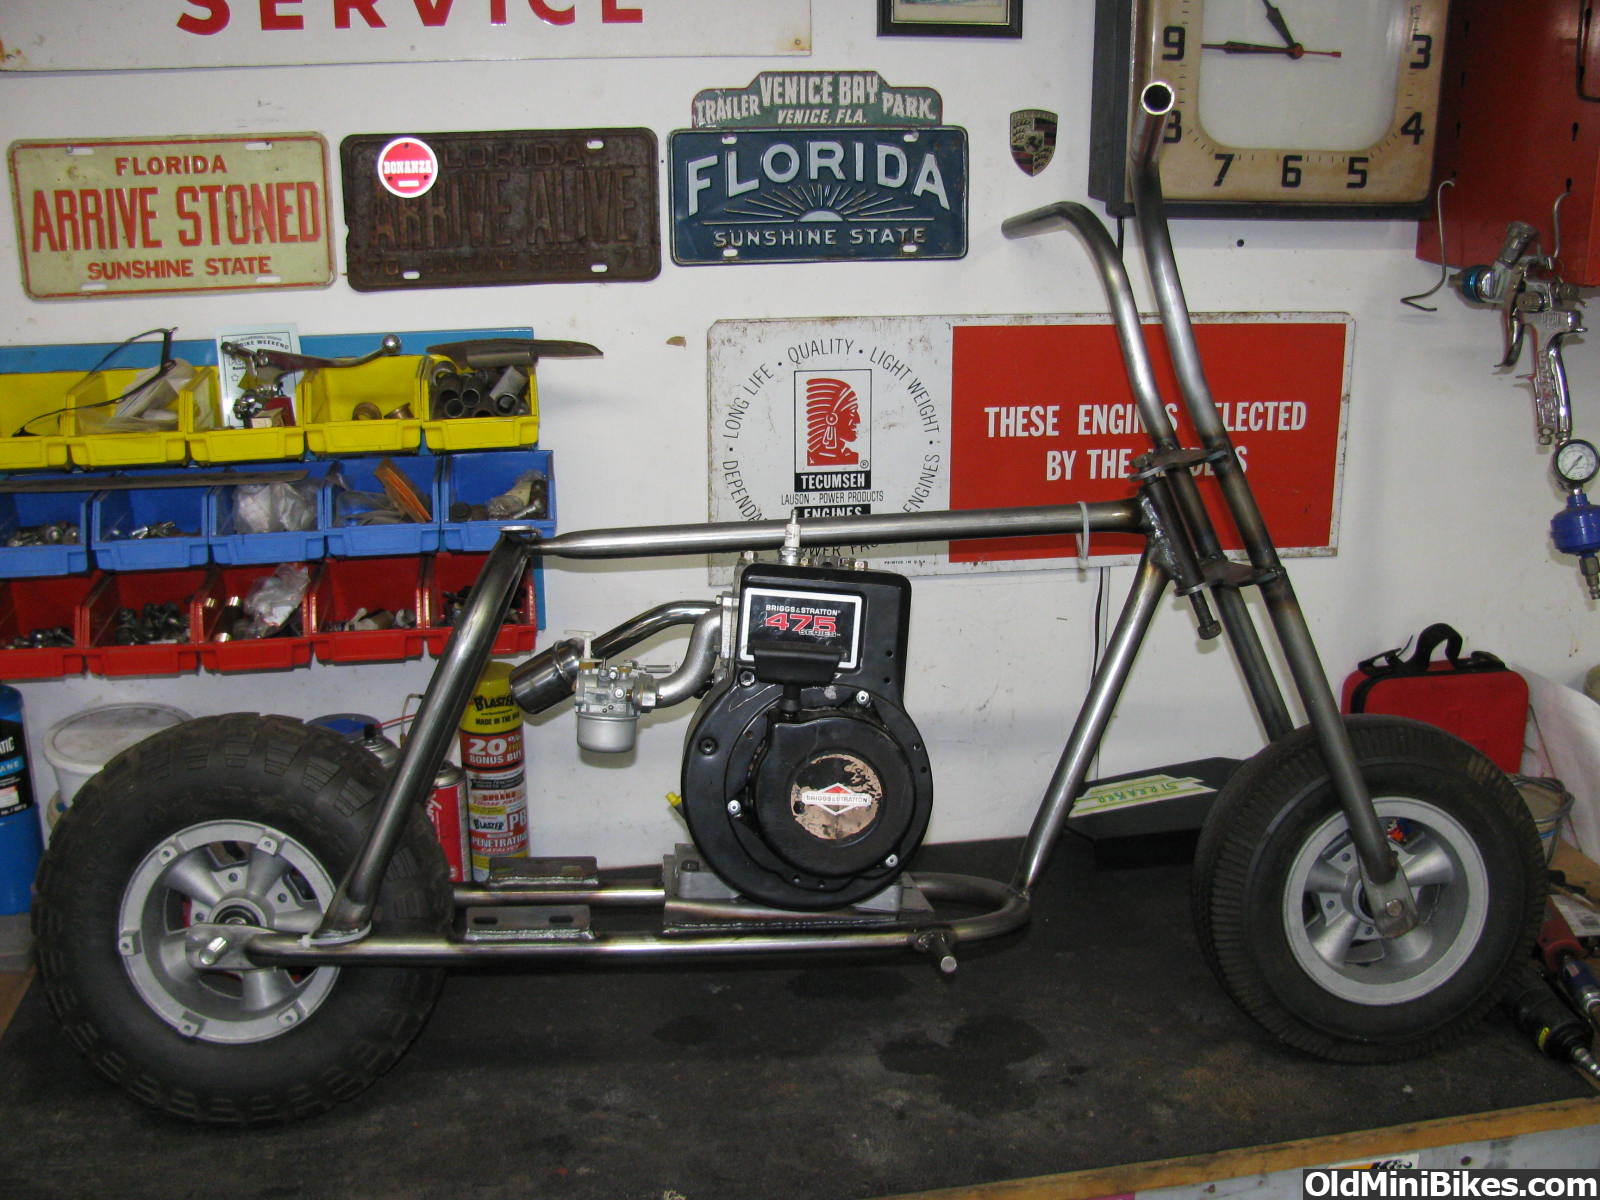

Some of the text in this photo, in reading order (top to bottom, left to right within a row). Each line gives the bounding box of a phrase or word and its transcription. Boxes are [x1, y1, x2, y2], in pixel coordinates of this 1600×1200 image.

[1162, 26, 1185, 61] 9
[1410, 35, 1432, 70] 3
[760, 75, 880, 106] VENICE BAY
[695, 94, 760, 121] TRAILER
[777, 109, 867, 125] VENICE, FLA.
[1400, 112, 1424, 145] 4
[115, 155, 228, 176] FLORIDA
[384, 160, 432, 175] BONANZA
[442, 141, 587, 169] LORIDA
[1213, 154, 1234, 187] 7
[687, 140, 950, 216] FLORIDA
[1281, 155, 1302, 188] 6
[1346, 156, 1367, 188] 5
[32, 181, 321, 253] ARRIVE STONED
[526, 167, 640, 246] ALIVE
[714, 227, 926, 247] SUNSHINE STATE
[87, 256, 273, 281] SUNSHINE STATE
[787, 338, 854, 364] QUALITY
[723, 363, 774, 439] LONG LIFE
[869, 346, 940, 433] LIGHT WEIGHT
[984, 401, 1306, 438] THESE ENGINS LECTED
[1046, 450, 1077, 480] BY
[1086, 448, 1132, 480] THE
[723, 460, 767, 521] DEPENDA
[902, 454, 940, 512] ENGINES
[801, 473, 865, 490] TECUMSEH
[781, 490, 884, 505] LAUSON POWER PRODUCTS
[766, 613, 837, 632] 475
[470, 754, 504, 764] BONUS
[472, 834, 527, 847] PENETRATIN
